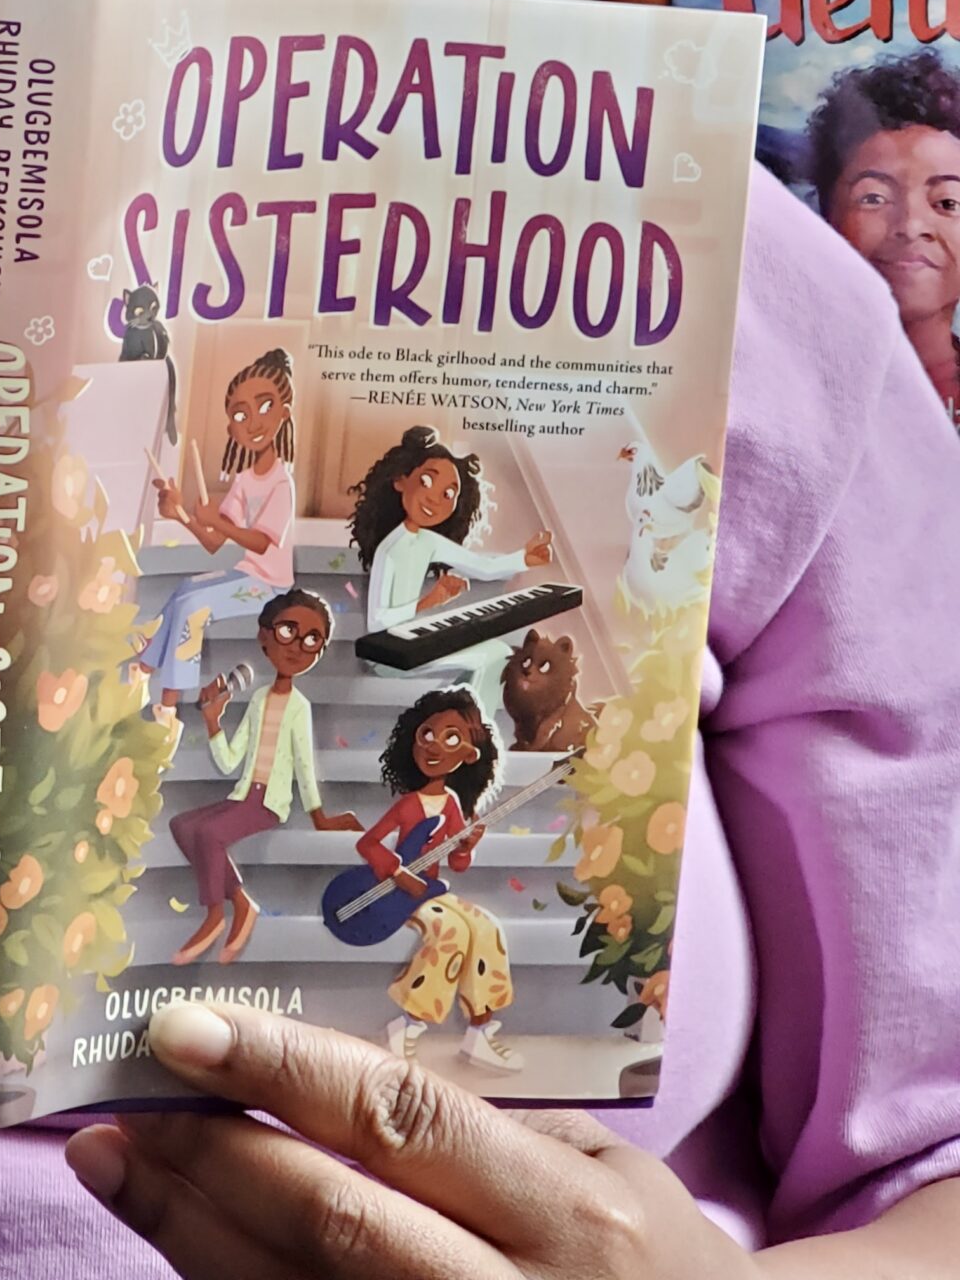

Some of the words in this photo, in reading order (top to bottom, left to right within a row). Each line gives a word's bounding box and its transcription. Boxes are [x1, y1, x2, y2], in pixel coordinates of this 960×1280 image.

[161, 33, 656, 190] OPERATION
[14, 58, 56, 264] OLUGBEMISOLA
[106, 190, 685, 348] SISTERHOOD
[308, 344, 344, 360] “This
[348, 348, 374, 360] ode
[378, 349, 391, 361] to
[396, 348, 433, 363] Black
[437, 350, 496, 367] girlhood
[500, 354, 523, 366] and
[530, 355, 552, 368] the
[556, 358, 642, 374] communities
[646, 360, 673, 374] that
[321, 371, 356, 382] serve
[360, 368, 395, 383] them
[399, 370, 438, 384] offers
[442, 374, 491, 388] humor,
[496, 376, 573, 393] tenderness,
[576, 379, 601, 392] and
[606, 379, 658, 396] charm.”
[350, 389, 426, 405] —RENÉE
[432, 394, 513, 411] WATSON,
[515, 396, 546, 410] New
[551, 399, 581, 415] York
[586, 401, 624, 416] Times
[462, 416, 535, 436] bestselling
[539, 421, 585, 436] author
